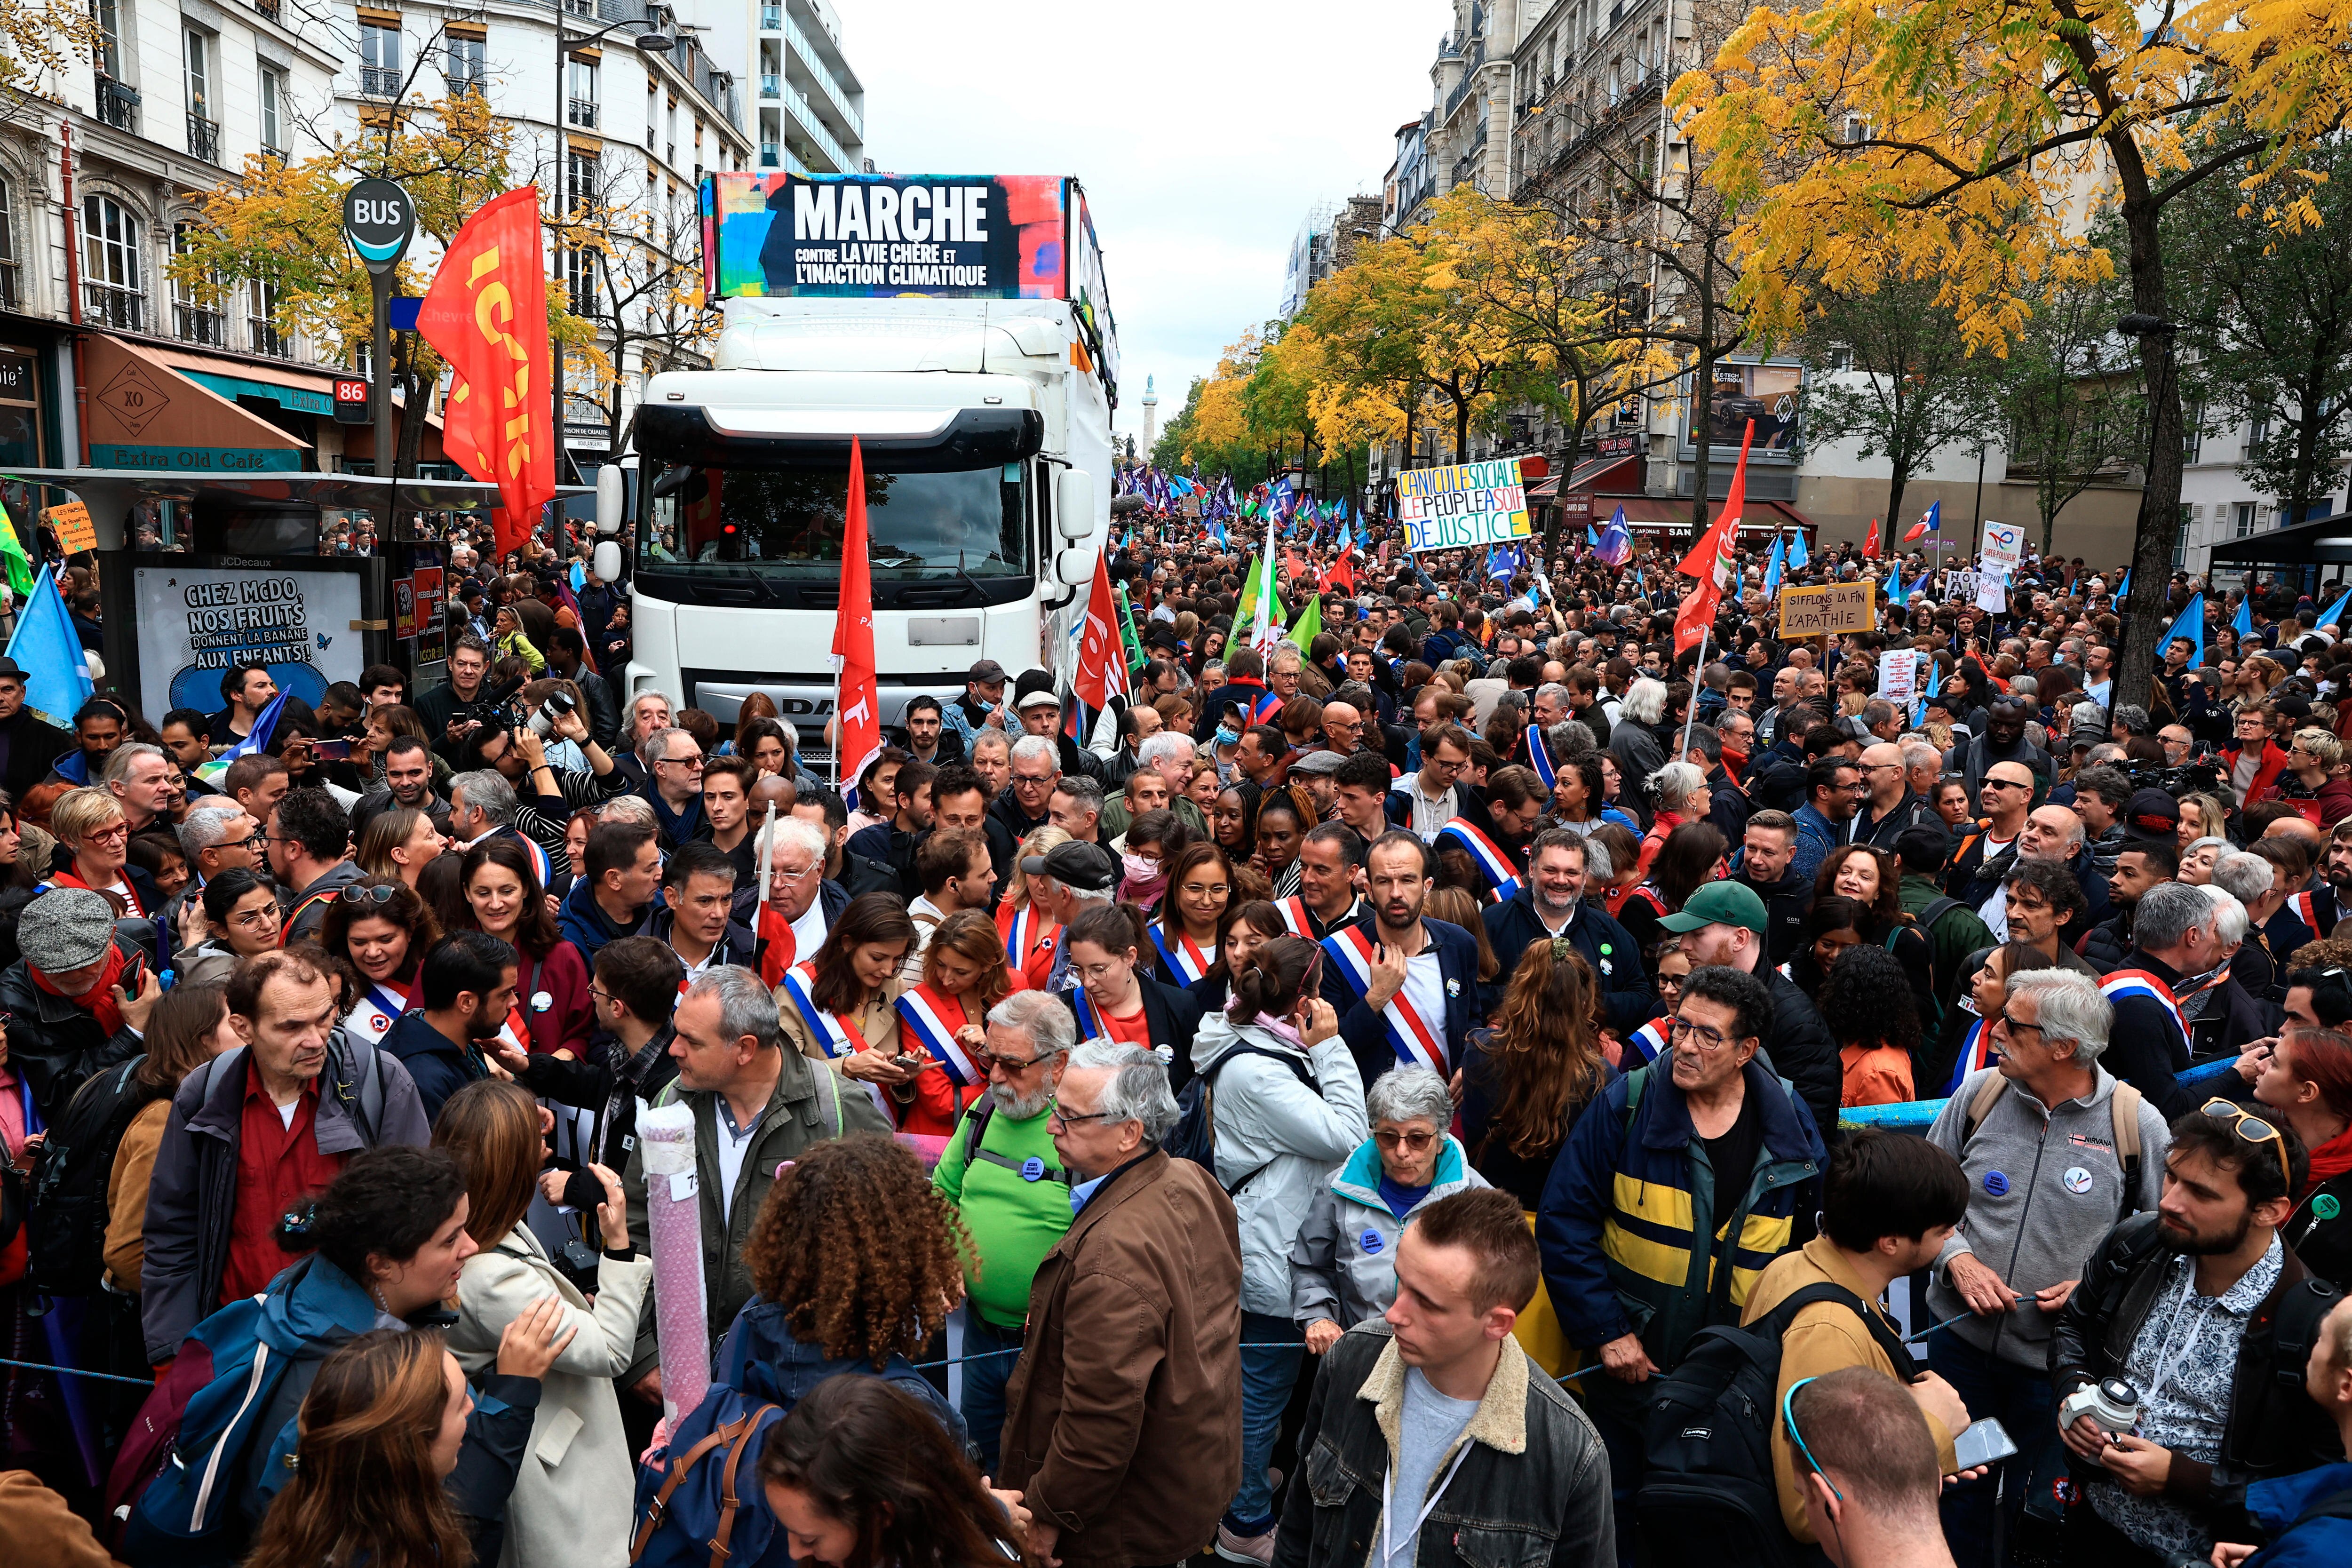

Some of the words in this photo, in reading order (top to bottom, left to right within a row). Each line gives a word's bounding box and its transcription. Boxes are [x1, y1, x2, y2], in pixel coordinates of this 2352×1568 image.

[354, 199, 401, 225] BUS
[794, 185, 988, 242] MARCHE
[795, 248, 838, 263] CONTRE
[841, 243, 861, 263] LA
[862, 243, 888, 263] VIE
[890, 239, 940, 263] CHÈRE
[943, 249, 956, 263] ET
[795, 263, 885, 284] L'INACTION
[888, 265, 987, 287] CLIMATIQUE
[424, 308, 472, 323] Chevre
[124, 391, 143, 407] XO
[340, 383, 364, 400] 86
[292, 391, 320, 410] Extra
[1600, 439, 1616, 452] SANYO
[1618, 438, 1632, 450] SUSHI
[114, 450, 168, 466] Extra
[177, 451, 211, 467] Old
[220, 453, 265, 468] Café
[221, 557, 271, 567] JCDecaux
[415, 558, 433, 567] Chevreul
[1984, 548, 2016, 562] SUPER-POLLUEUR
[185, 582, 237, 607] CHEZ
[240, 577, 303, 604] McDO,
[417, 589, 442, 600] REBELLION
[1837, 593, 1846, 603] LA
[187, 610, 230, 633] NOS
[234, 604, 306, 630] FRUITS
[398, 614, 415, 628] UPML
[191, 633, 245, 650] DONNENT
[246, 632, 262, 645] LA
[262, 628, 308, 643] BANANE
[196, 651, 231, 669] AUX
[420, 648, 436, 662] ICOR
[2085, 1136, 2112, 1147] NIRVANA
